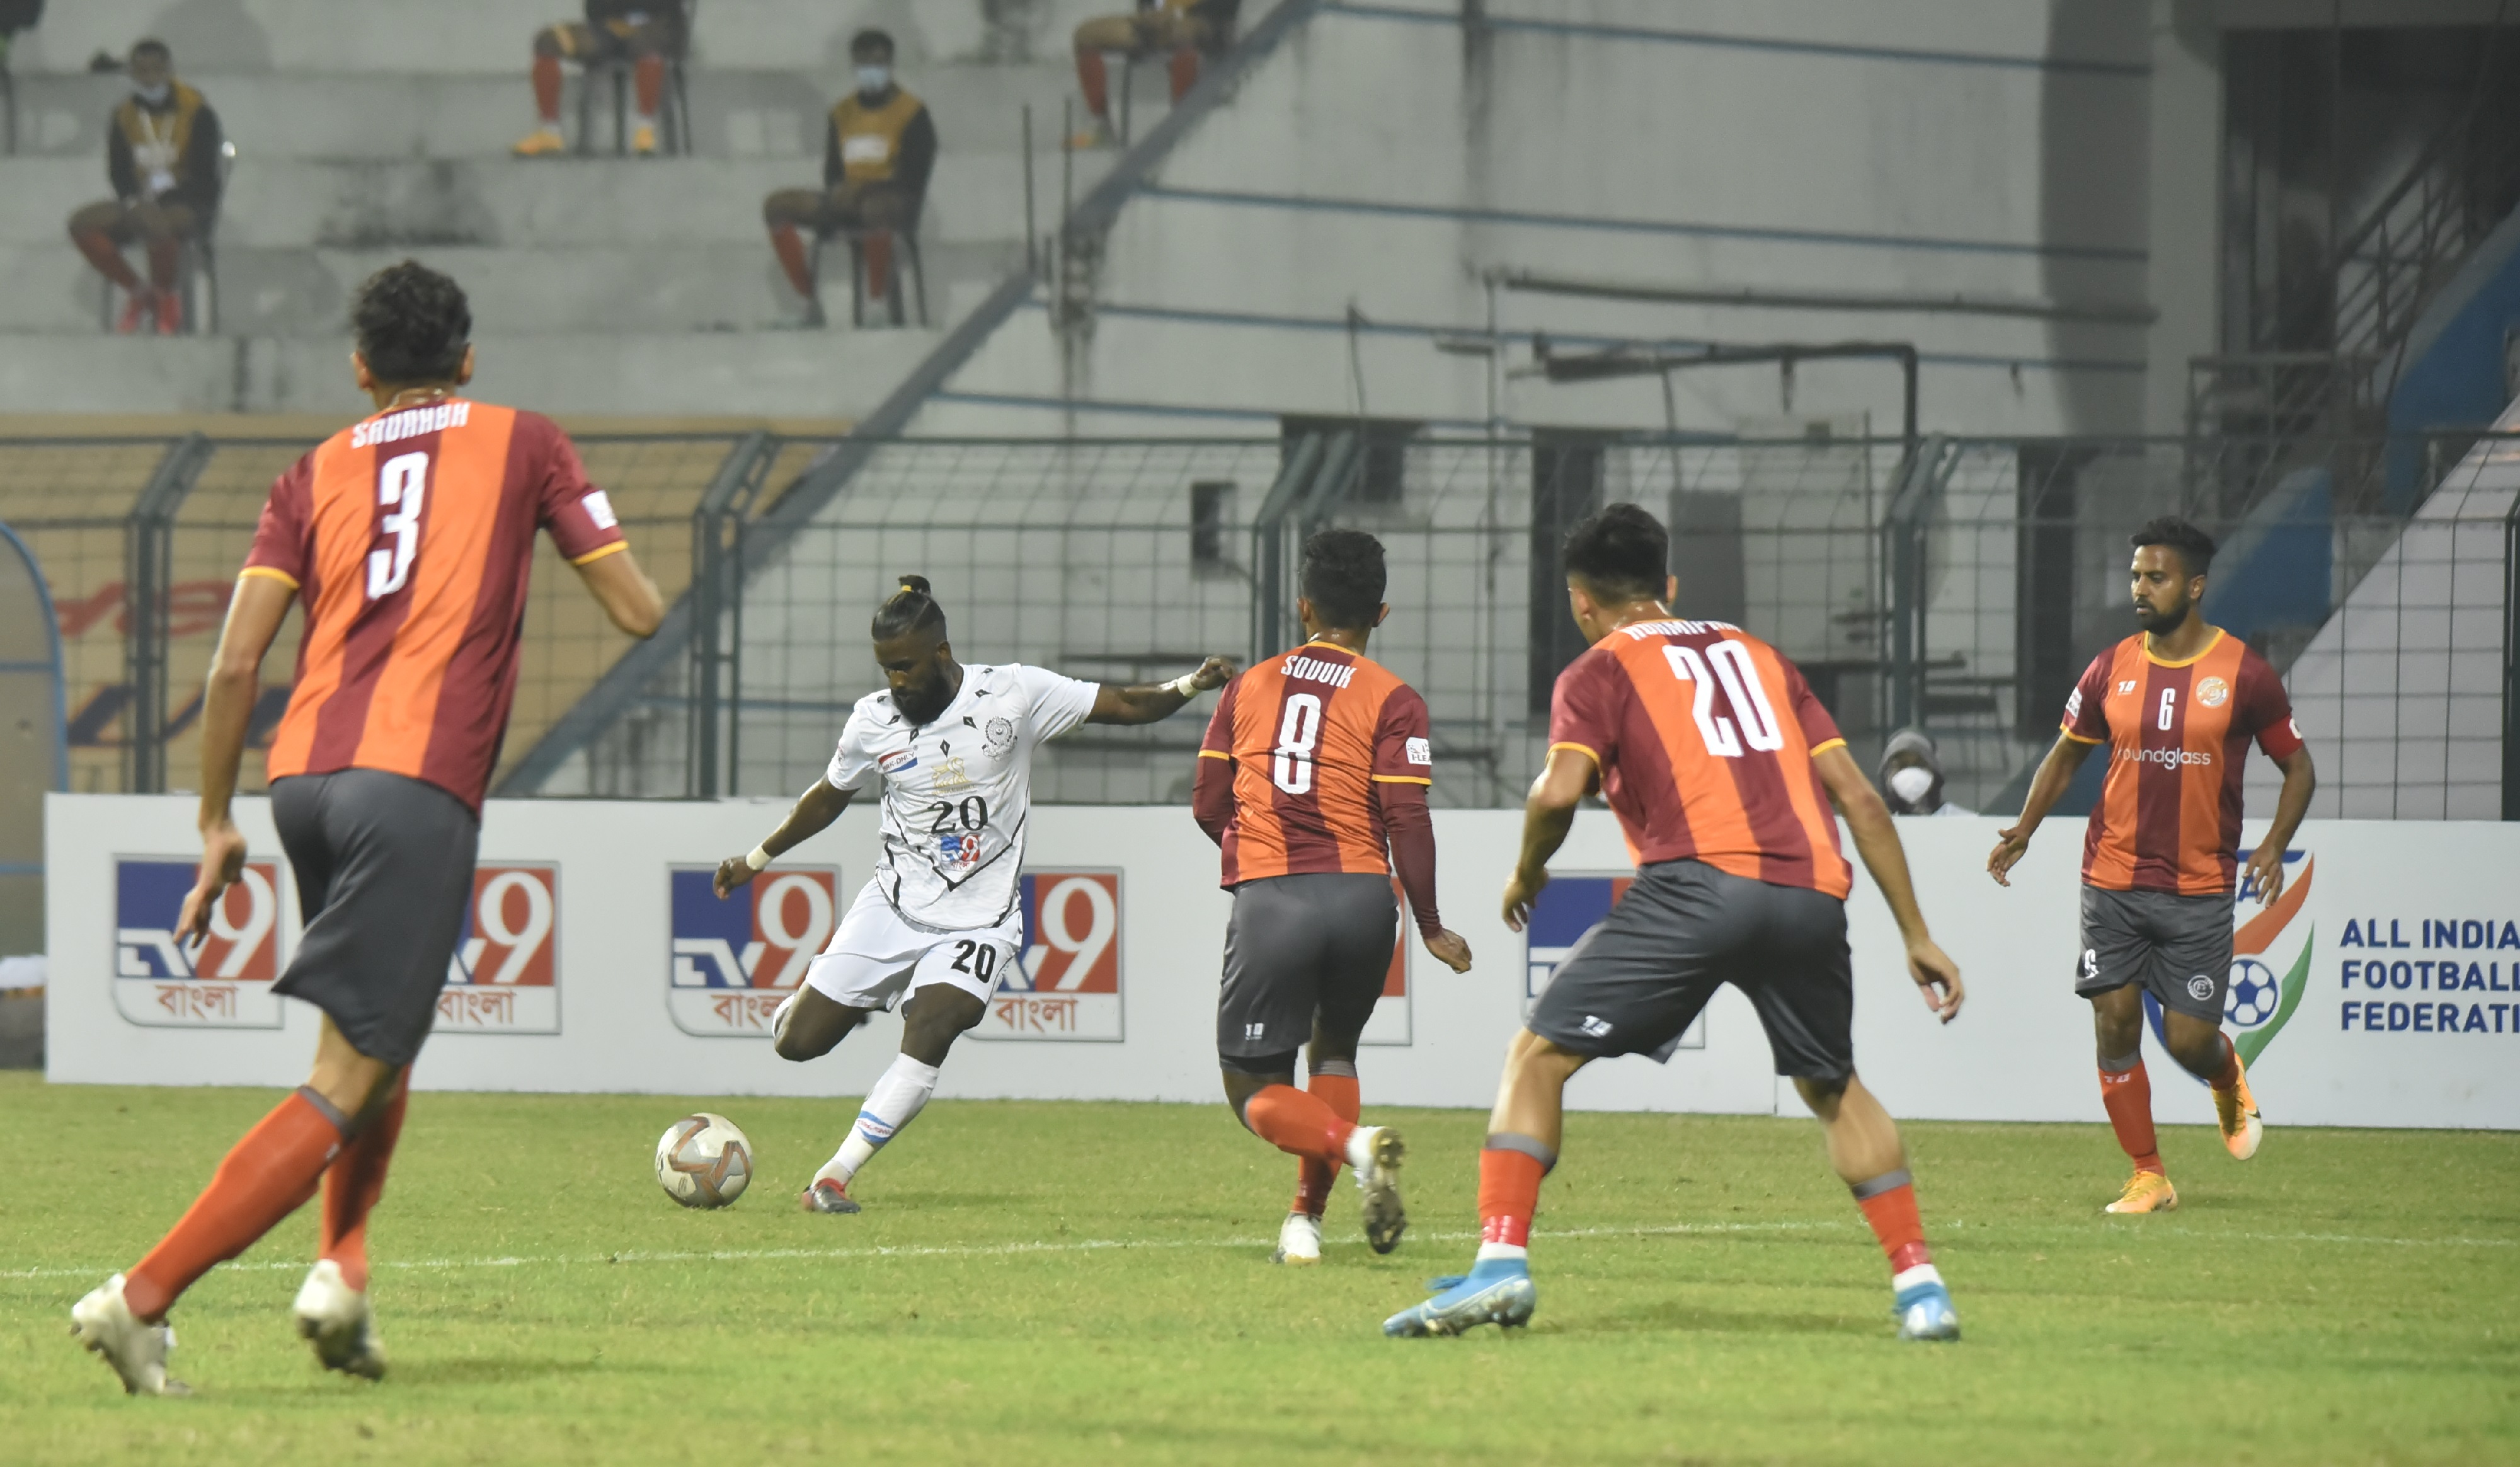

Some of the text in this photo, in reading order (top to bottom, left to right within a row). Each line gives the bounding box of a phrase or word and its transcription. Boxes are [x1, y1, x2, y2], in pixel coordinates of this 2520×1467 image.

[367, 451, 429, 599] 3
[1661, 640, 1784, 757] 20
[2158, 687, 2175, 730] 6
[1274, 693, 1321, 794] 8
[2118, 746, 2211, 769] roundglass
[927, 796, 988, 833] 20
[673, 875, 833, 986] TV9
[2339, 918, 2520, 950] ALL INDIA
[950, 939, 996, 983] 20
[156, 983, 239, 1021] বাংলা
[711, 993, 784, 1029] বাংল
[993, 995, 1079, 1033] বাংলা
[2341, 1001, 2520, 1033] FEDERATI
